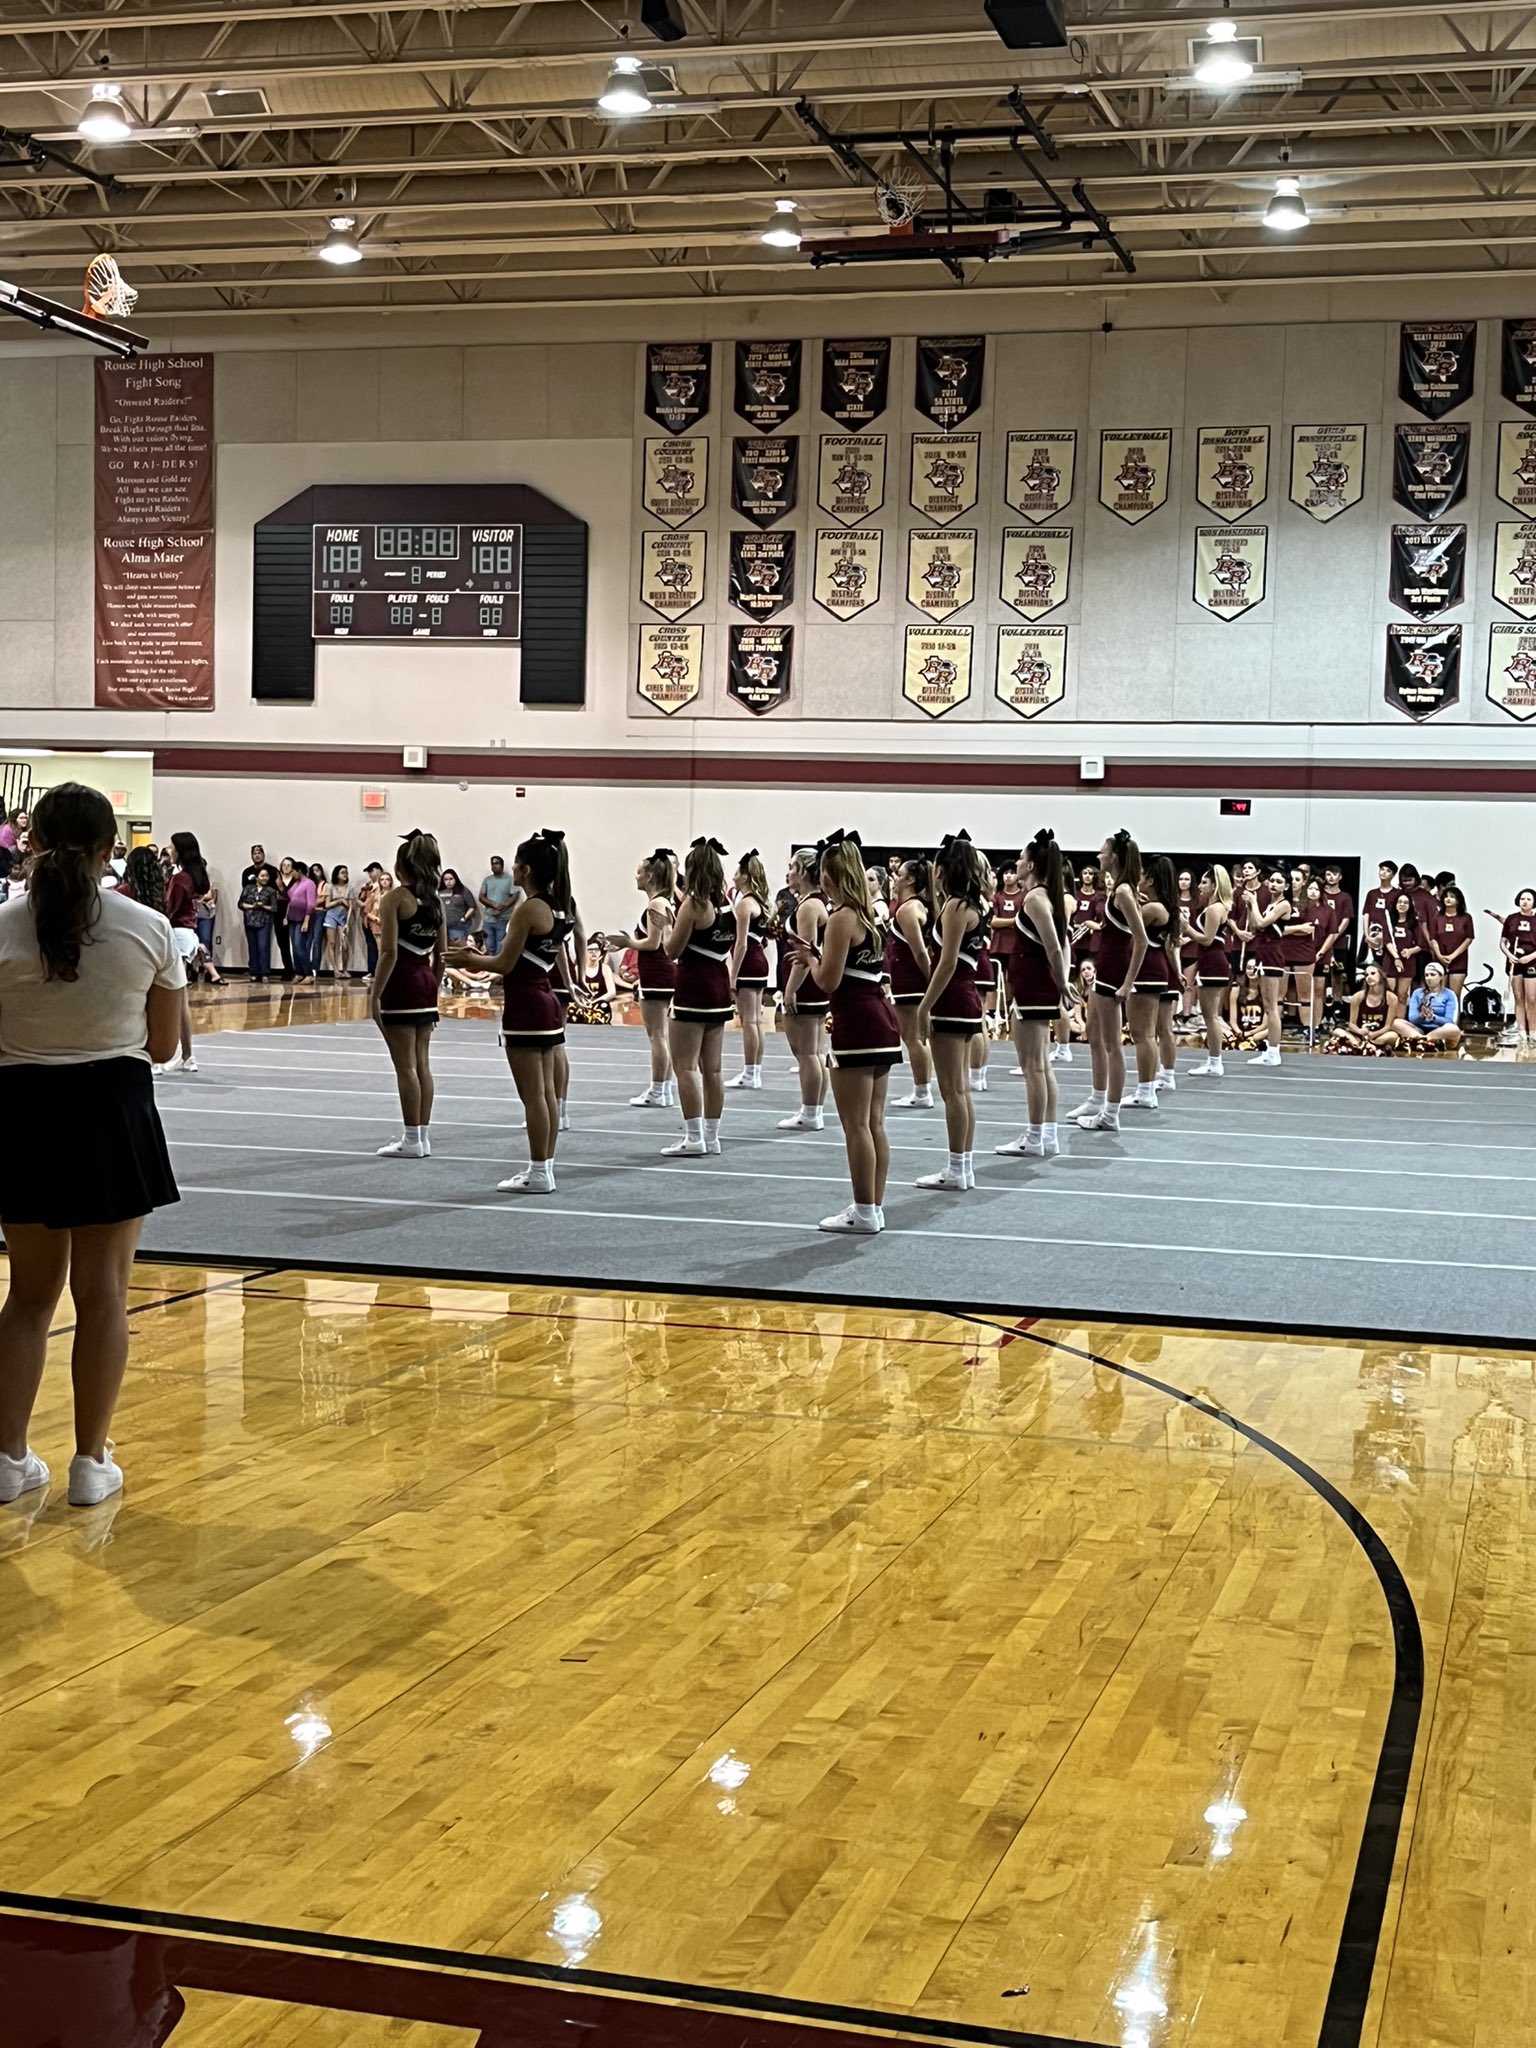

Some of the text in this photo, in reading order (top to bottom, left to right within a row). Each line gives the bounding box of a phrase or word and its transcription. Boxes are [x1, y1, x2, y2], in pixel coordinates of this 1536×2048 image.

[105, 358, 203, 372] Rouse High School
[126, 377, 182, 390] Fight Song
[1011, 434, 1073, 442] VOLLEYBALL
[1104, 433, 1168, 441] VOLLEYBALL
[1201, 436, 1265, 445] BASKETBALL
[109, 461, 124, 469] GO
[161, 475, 178, 483] Gold
[326, 530, 359, 542] HOME
[472, 530, 514, 542] VISITOR
[820, 532, 879, 540] FOOTBALL
[104, 537, 203, 549] Rouse High School
[121, 553, 184, 563] Alma Mater
[1213, 589, 1245, 597] DISTRICT
[331, 594, 354, 603] FOULS
[387, 594, 449, 603] PLAYER FOULS
[480, 595, 504, 604] FOULS
[909, 628, 971, 636] VOLLEYBALL
[1493, 626, 1523, 634] GIRLS
[922, 687, 951, 695] DISTRICT
[1015, 687, 1045, 695] DISTRICT
[917, 695, 955, 703] CHAMPIONS
[1010, 696, 1049, 704] CHAMPIONS
